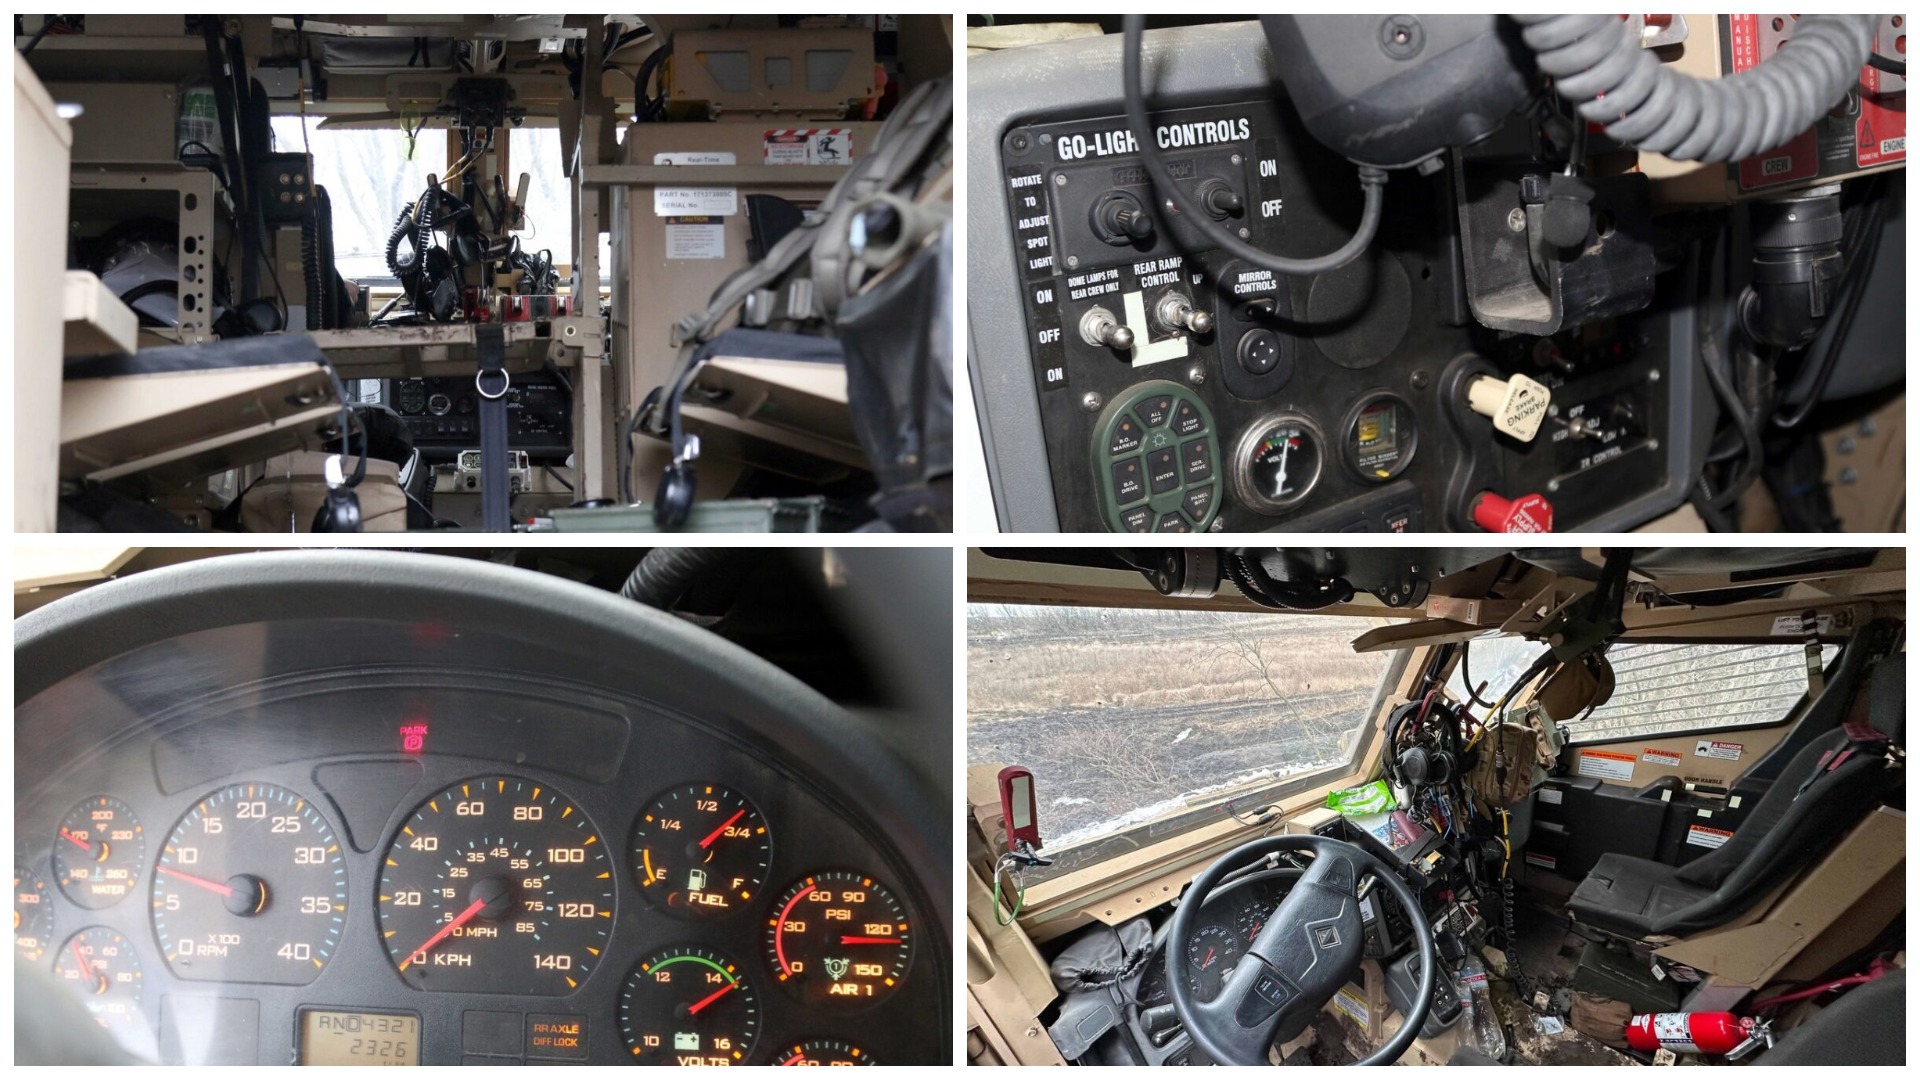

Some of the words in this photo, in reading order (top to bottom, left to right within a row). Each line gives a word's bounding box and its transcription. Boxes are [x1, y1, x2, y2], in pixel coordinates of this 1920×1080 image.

[1057, 130, 1140, 160] GO-LIGH
[1157, 118, 1250, 148] CONTROLS
[1883, 139, 1905, 152] ENGINE
[1260, 160, 1277, 177] ON
[1765, 159, 1789, 173] CREW
[1011, 174, 1042, 188] ROTATE
[1024, 196, 1036, 207] TO
[1262, 200, 1282, 218] OFF
[1019, 215, 1050, 229] ADJUST
[1027, 236, 1048, 249] SPOT
[1029, 256, 1053, 269] LIGHT
[1134, 262, 1157, 276] REAR
[1158, 256, 1183, 271] RAMP
[1068, 276, 1085, 288] DOME
[1086, 272, 1106, 284] LAMPS
[1107, 269, 1119, 280] FOR
[1141, 271, 1180, 288] CONTROL
[1193, 274, 1203, 285] UP
[1238, 270, 1272, 283] MIRROR
[1071, 289, 1087, 300] REAR
[1087, 286, 1105, 297] CREW
[1105, 281, 1119, 294] ONLY
[1234, 280, 1277, 294] CONTROLS
[1036, 289, 1053, 304] ON
[1039, 329, 1061, 344] OFF
[1047, 368, 1063, 382] ON
[1515, 396, 1536, 412] BRAKE
[1507, 397, 1546, 427] PARKING
[1569, 404, 1585, 418] OFF
[1151, 416, 1162, 424] OFF
[1182, 418, 1197, 426] STOP
[1182, 423, 1199, 432] LIGHT
[1112, 441, 1138, 451] MARKER
[1581, 458, 1591, 469] IR
[1592, 446, 1623, 464] CONTROL
[1190, 464, 1206, 473] DRIVE
[1156, 472, 1175, 482] ENTER
[1121, 484, 1139, 494] DRIVE
[1190, 492, 1208, 501] PANEL
[1128, 512, 1146, 522] PANEL
[1163, 519, 1179, 528] PARK
[400, 725, 428, 736] PARK
[1651, 750, 1680, 758] WARNING
[237, 802, 266, 819] 20
[457, 802, 485, 816] 60
[696, 800, 718, 812] 1/2
[92, 811, 113, 821] 200
[513, 806, 543, 821] 80
[202, 817, 223, 834] 15
[271, 816, 301, 833] 25
[660, 819, 681, 831] 1/4
[71, 831, 89, 840] 170
[112, 831, 133, 840] 230
[724, 826, 750, 838] 3/4
[1700, 827, 1732, 837] WARNING
[410, 837, 438, 851] 40
[177, 848, 198, 864] 10
[294, 848, 326, 864] 30
[466, 852, 486, 863] 35
[490, 848, 509, 858] 45
[548, 848, 585, 863] 100
[511, 860, 529, 870] 55
[70, 869, 88, 878] 140
[106, 869, 128, 879] 260
[450, 868, 469, 878] 25
[656, 870, 667, 880] E
[523, 879, 542, 889] 65
[732, 878, 744, 889] F
[92, 885, 125, 895] WATER
[442, 888, 456, 898] 15
[19, 894, 40, 904] 300
[166, 894, 180, 911] 5
[394, 892, 421, 906] 20
[689, 893, 728, 907] FUEL
[809, 891, 832, 902] 60
[842, 892, 865, 903] 90
[301, 897, 331, 914] 35
[525, 902, 544, 911] 75
[558, 904, 595, 918] 120
[444, 912, 454, 922] 5
[825, 909, 851, 920] PSI
[453, 927, 463, 937] 0
[466, 927, 498, 938] MPH
[516, 923, 536, 933] 85
[784, 921, 806, 933] 30
[864, 923, 892, 935] 120
[17, 938, 37, 948] 400
[179, 939, 194, 956] 0
[197, 945, 228, 957] RPM
[103, 947, 118, 956] 60
[277, 944, 310, 960] 40
[92, 959, 107, 969] PSI
[413, 951, 427, 965] 0
[434, 954, 472, 966] KPH
[534, 955, 571, 970] 140
[791, 961, 803, 973] 0
[855, 964, 882, 976] 150
[64, 969, 79, 979] 20
[117, 973, 132, 982] 80
[655, 972, 670, 982] 12
[705, 973, 722, 984] 14
[830, 983, 858, 996] AIR
[866, 985, 873, 996] 1
[534, 1024, 549, 1034] RR
[549, 1024, 579, 1035] AXLE
[533, 1037, 553, 1047] DIFF
[553, 1037, 578, 1047] LOCK
[643, 1035, 659, 1047] 10
[713, 1038, 730, 1050] 16
[350, 1038, 407, 1058] 2326
[677, 1056, 729, 1066] VOLTS
